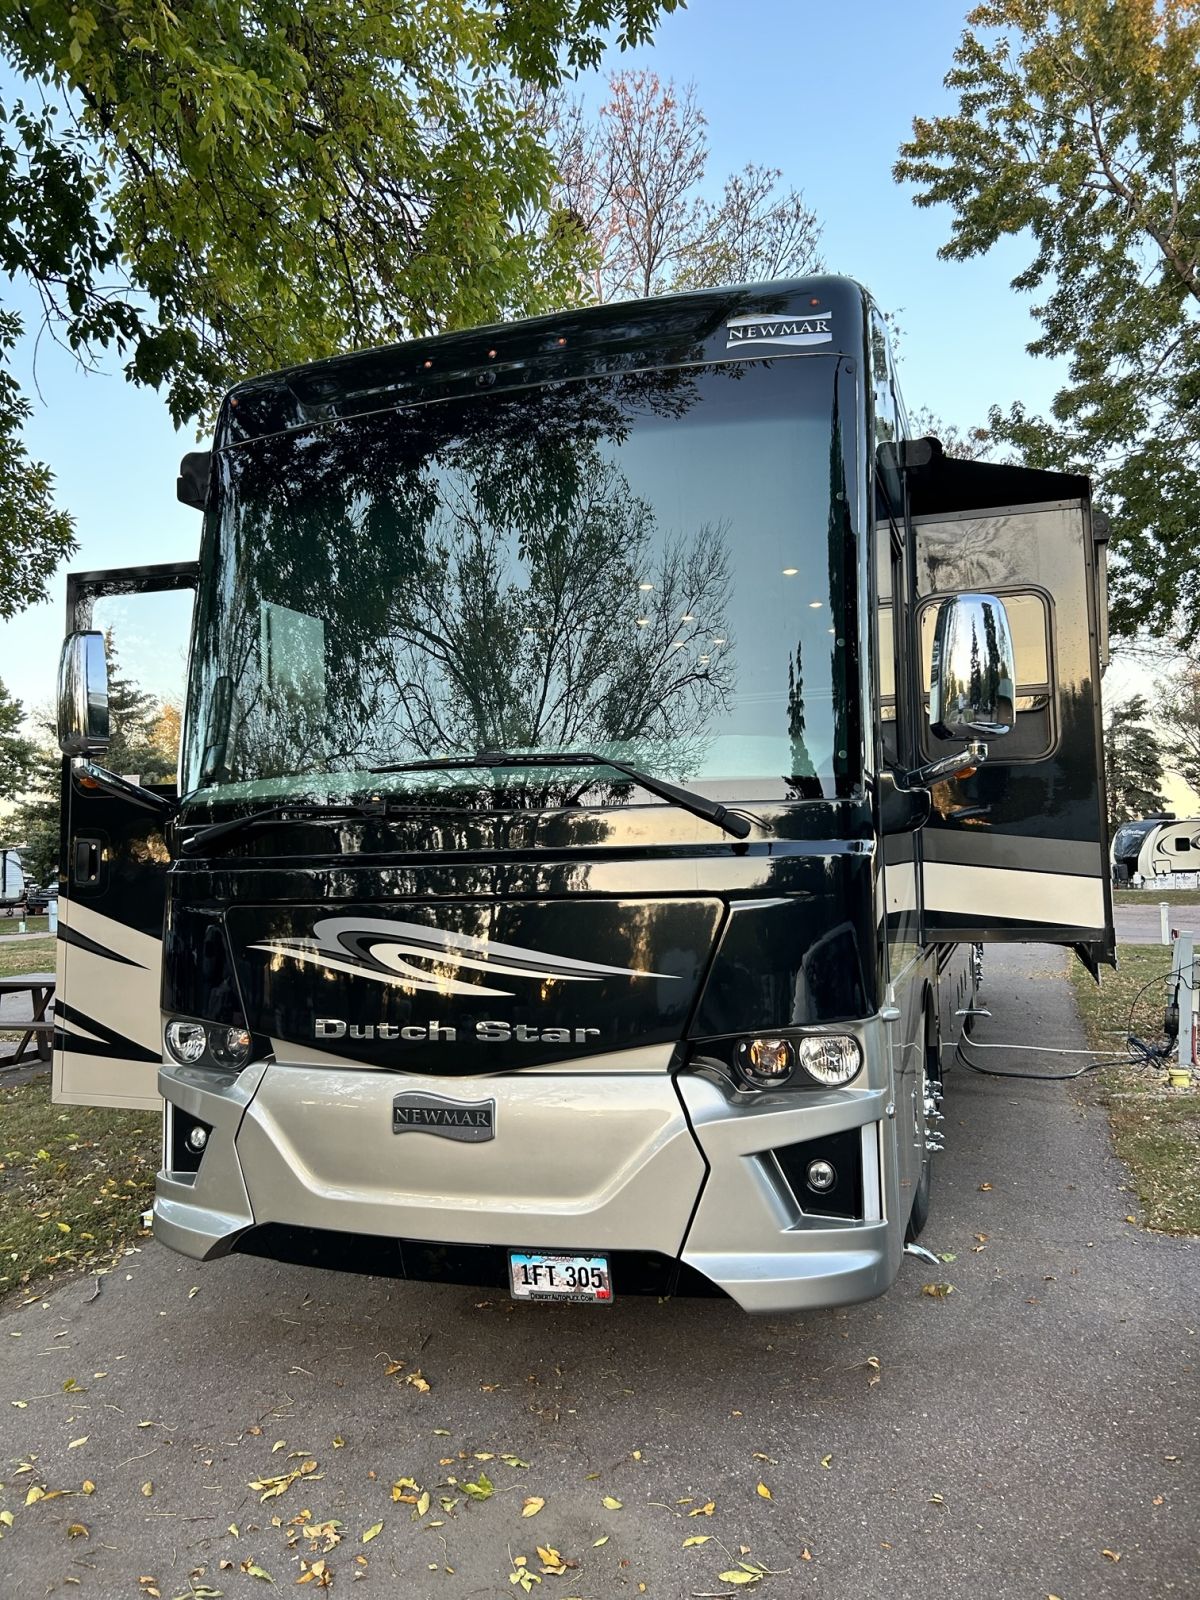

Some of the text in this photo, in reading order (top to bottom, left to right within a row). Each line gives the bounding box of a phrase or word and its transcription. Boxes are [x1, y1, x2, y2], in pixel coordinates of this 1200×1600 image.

[729, 320, 831, 340] NEWMAR
[315, 1018, 600, 1043] Dutch Star
[395, 1108, 490, 1126] NEWMAR
[521, 1264, 603, 1288] 1FT 305
